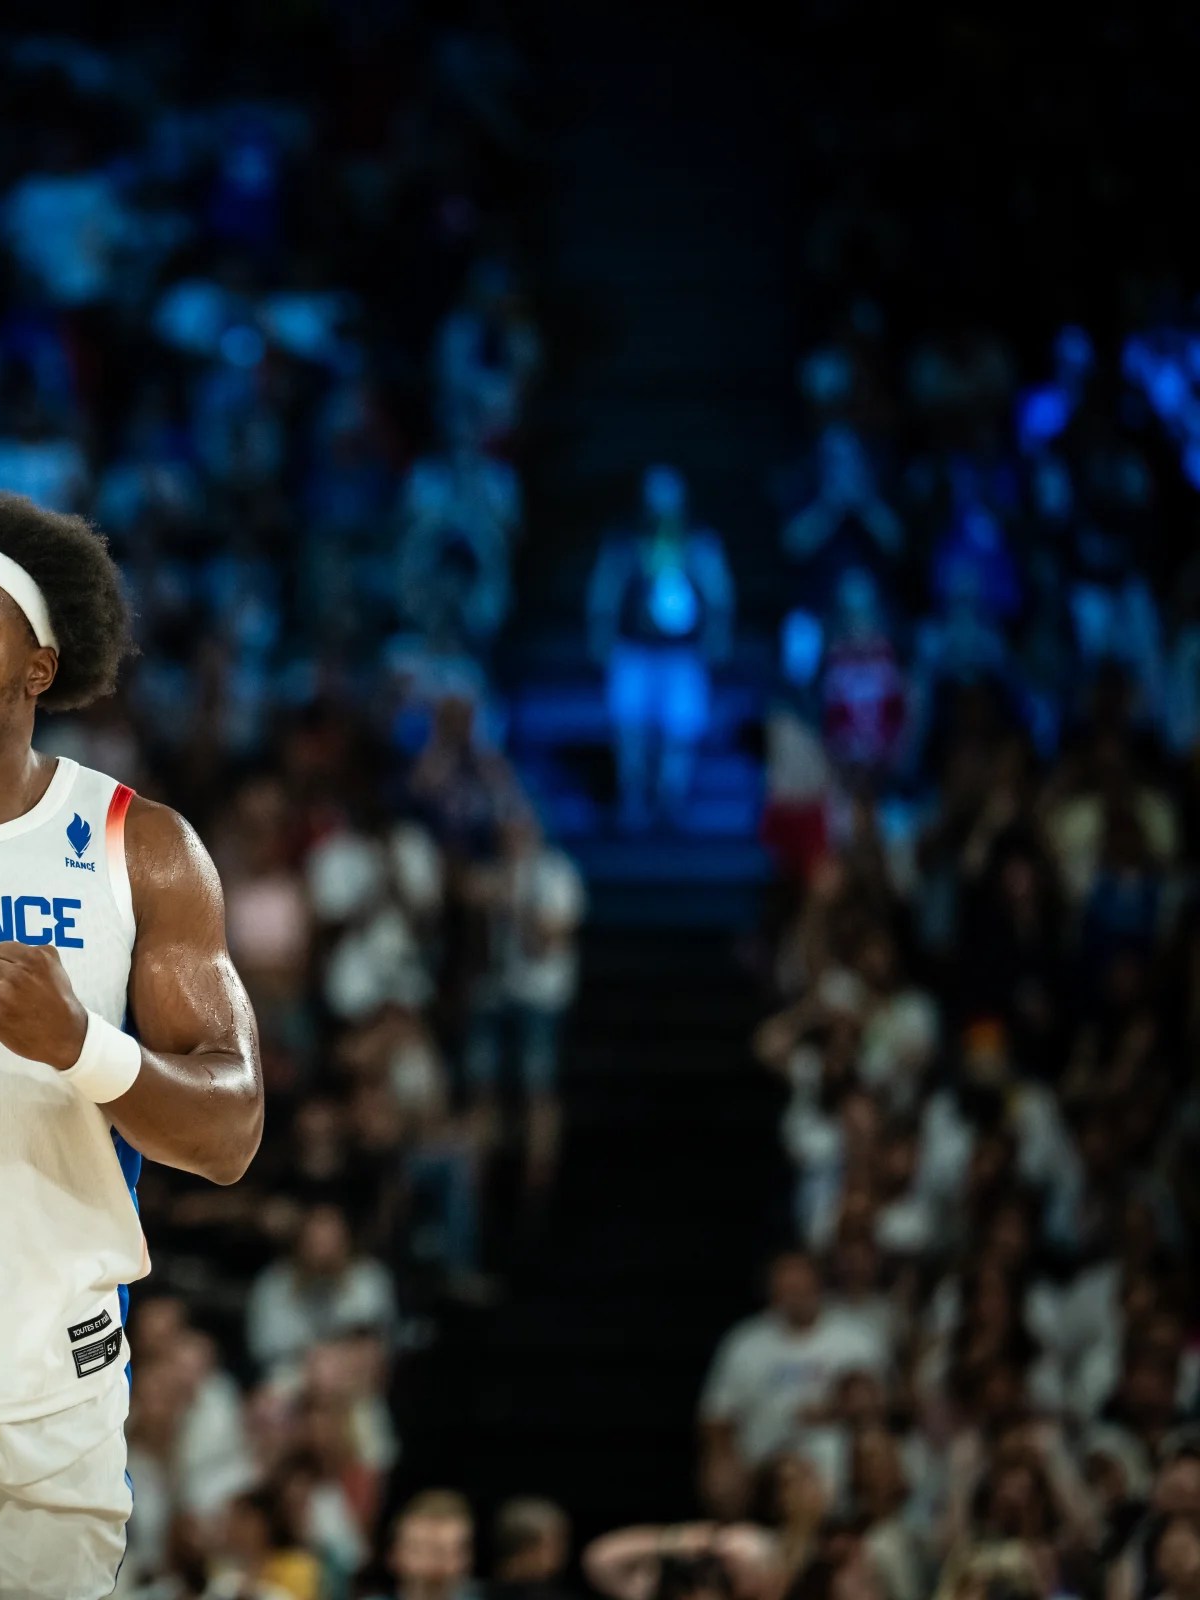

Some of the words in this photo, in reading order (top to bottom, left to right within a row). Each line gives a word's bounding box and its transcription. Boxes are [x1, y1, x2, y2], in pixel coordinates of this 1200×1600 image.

[64, 857, 96, 872] FRANCE
[73, 1324, 94, 1337] TOUTES
[95, 1320, 102, 1328] ET
[107, 1341, 117, 1355] 54
